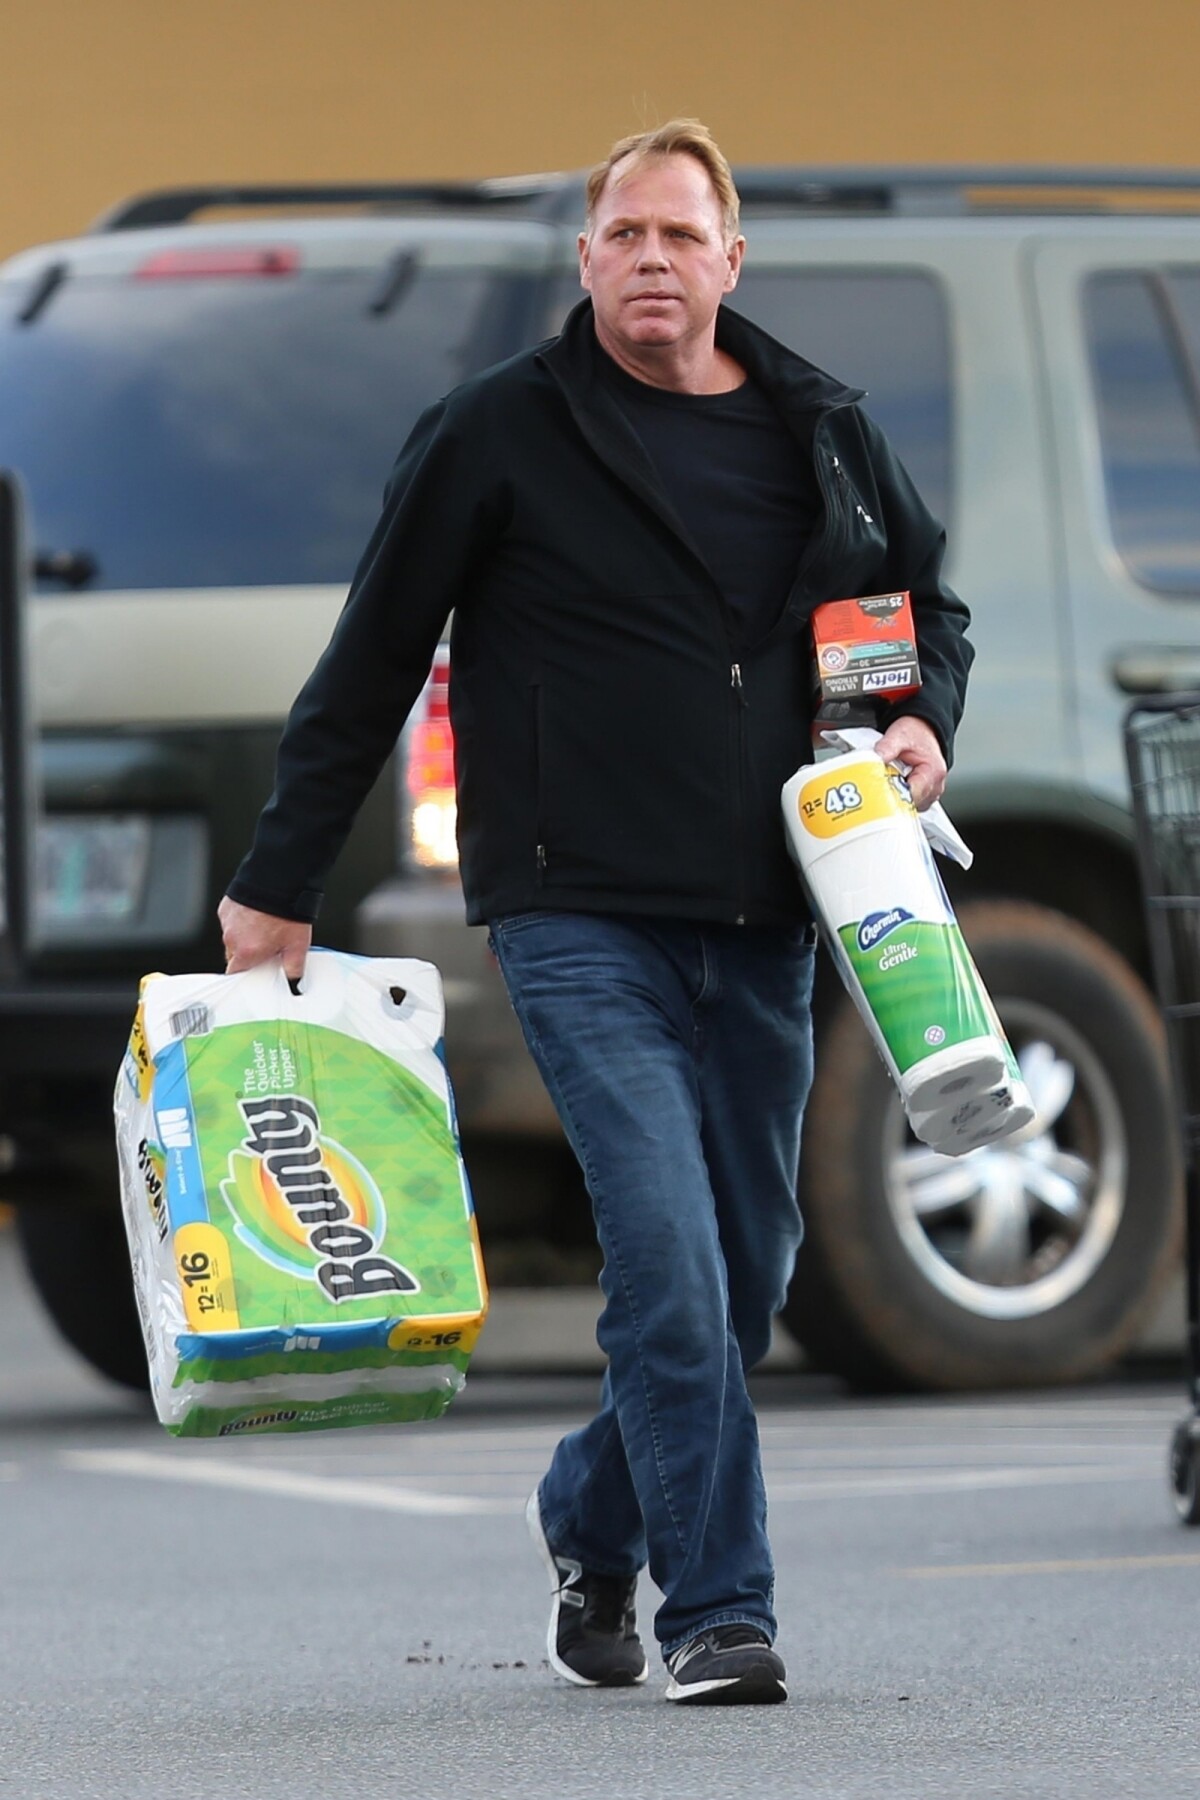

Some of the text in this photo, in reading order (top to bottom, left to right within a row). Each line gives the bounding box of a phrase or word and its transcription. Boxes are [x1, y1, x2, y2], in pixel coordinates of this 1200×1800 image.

[889, 596, 903, 607] 25
[825, 676, 858, 687] STRONG
[830, 683, 856, 692] ULTRA
[866, 671, 908, 686] Hefty
[861, 910, 902, 945] Charmin
[879, 947, 918, 971] Gentle
[883, 942, 907, 957] Ultra
[253, 1040, 269, 1092] Quicker
[269, 1048, 282, 1088] Picker
[244, 1068, 256, 1093] The
[238, 1095, 420, 1303] Bounty
[218, 1410, 298, 1436] Bounty
